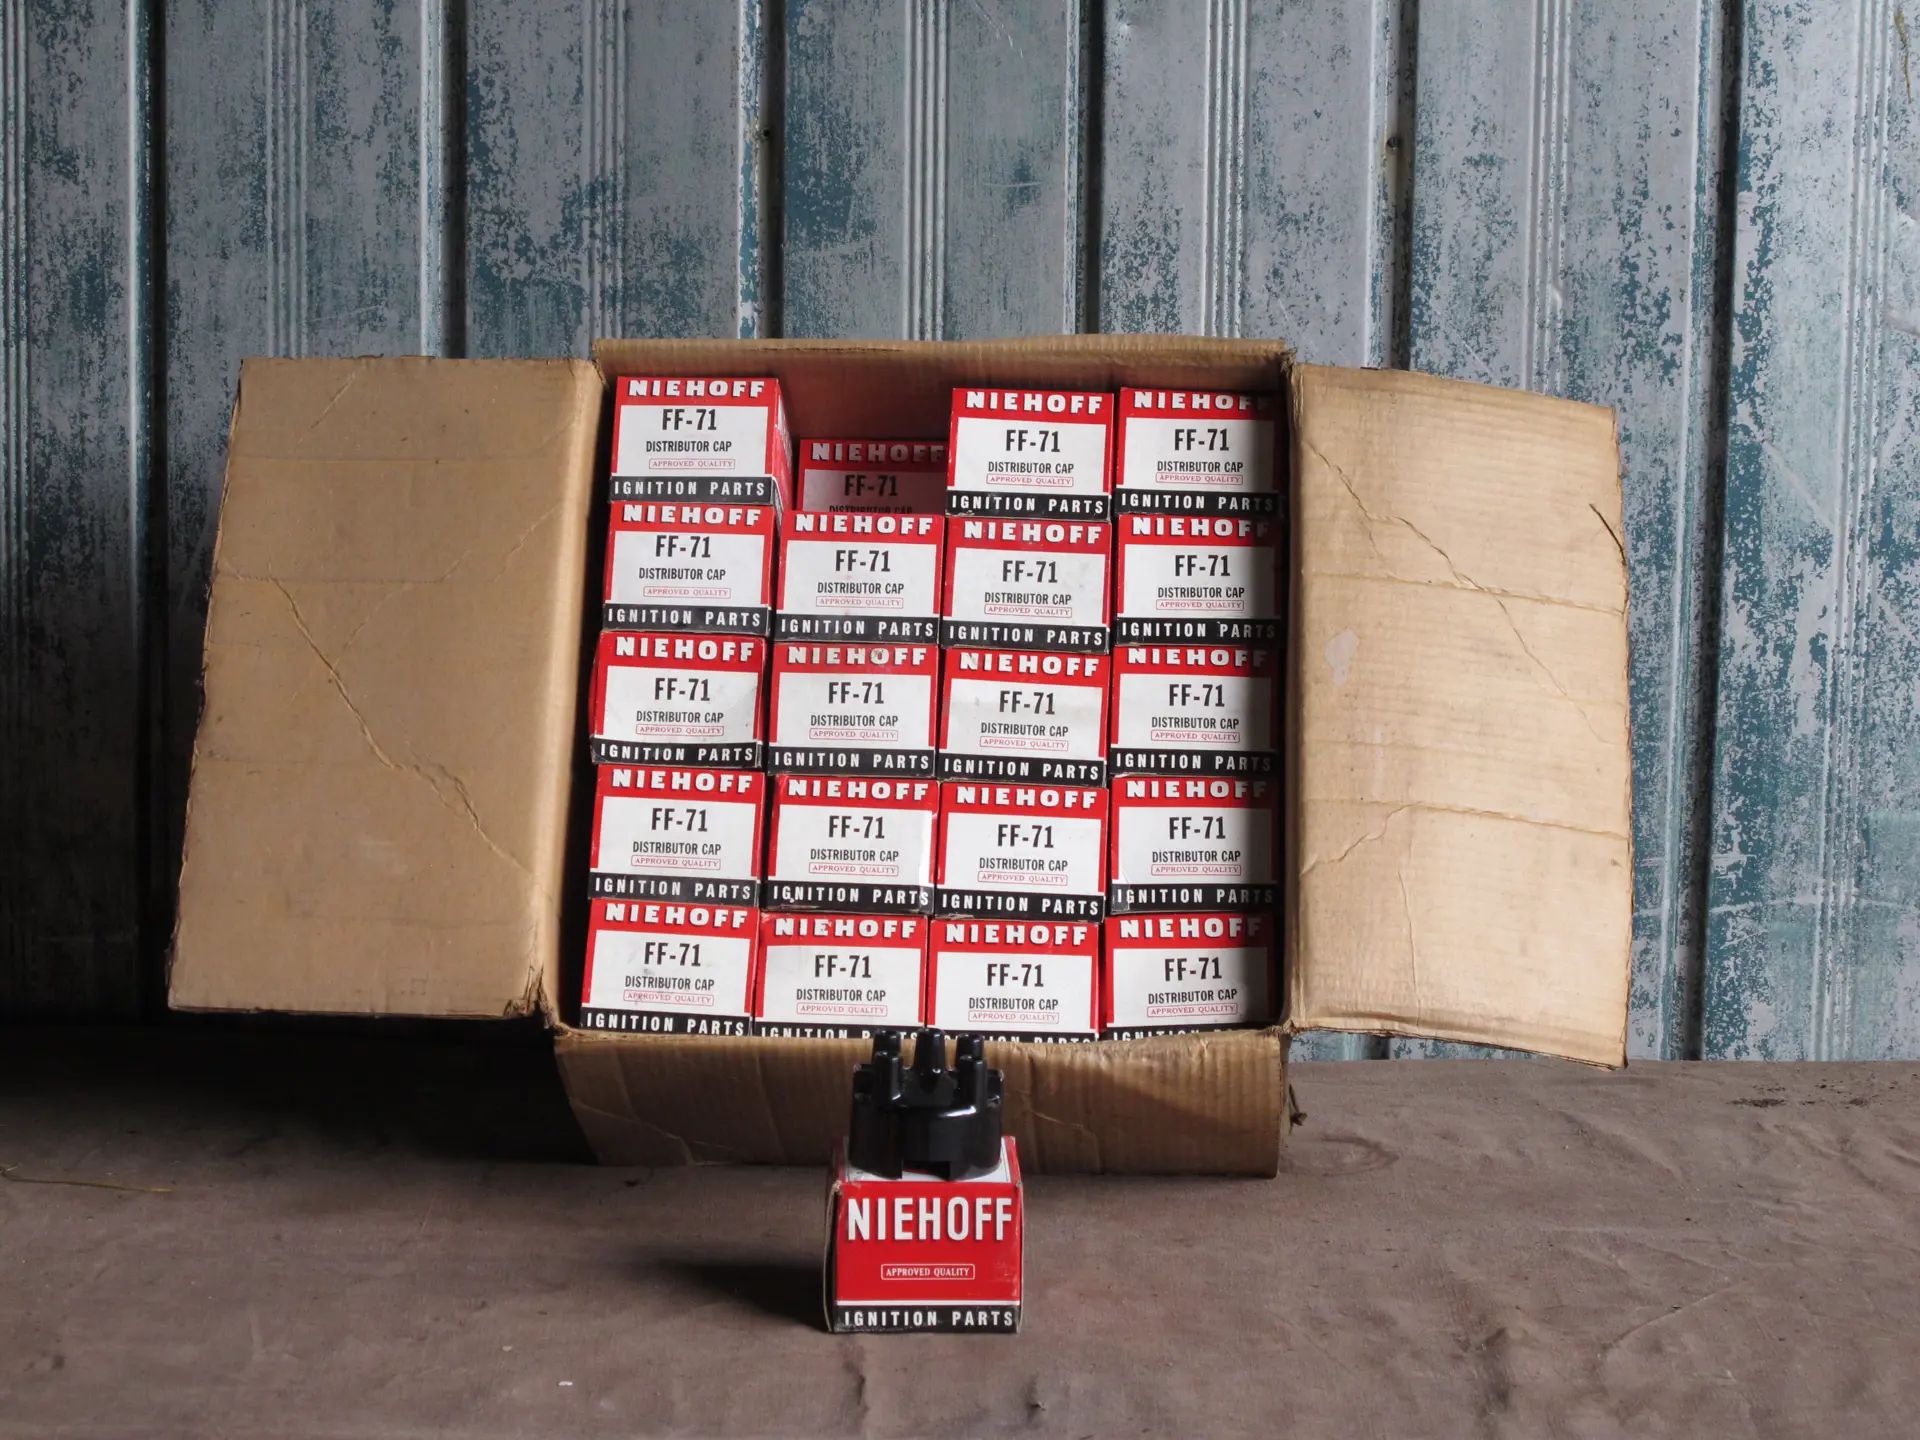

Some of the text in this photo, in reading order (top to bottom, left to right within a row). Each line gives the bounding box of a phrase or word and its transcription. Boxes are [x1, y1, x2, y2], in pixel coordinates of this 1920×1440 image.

[628, 380, 765, 398] NIEHOFF
[966, 392, 1102, 414] NIEHOFF
[1134, 392, 1267, 411] NIEHOFF
[662, 408, 717, 430] FF-71
[646, 441, 732, 452] DISTRIBUTOR CAP
[1006, 430, 1061, 452] FF-71
[1175, 429, 1229, 451] FF-71
[811, 443, 944, 462] NIEHOFF
[653, 460, 733, 468] APPROVED QUALITY
[988, 462, 1074, 474] DISTRIBUTOR CAP
[1157, 461, 1243, 473] DISTRIBUTOR CAP
[844, 475, 898, 497] FF-71
[990, 476, 1071, 485] APPROVED QUALITY
[1160, 474, 1241, 483] APPROVED QUALITY
[615, 482, 765, 495] IGNITION PARTS
[952, 495, 1103, 514] IGNITION PARTS
[1122, 494, 1273, 511] IGNITION PARTS
[623, 505, 761, 526] NIEHOFF
[796, 514, 933, 535] NIEHOFF
[964, 521, 1102, 544] NIEHOFF
[1132, 518, 1268, 537] NIEHOFF
[656, 535, 711, 558] FF-71
[835, 550, 890, 572] FF-71
[1175, 555, 1230, 577] FF-71
[639, 568, 726, 580] DISTRIBUTOR CAP
[1002, 561, 1058, 583] FF-71
[647, 588, 729, 597] APPROVED QUALITY
[817, 582, 904, 594] DISTRIBUTOR CAP
[1158, 587, 1244, 599] DISTRIBUTOR CAP
[819, 598, 901, 607] APPROVED QUALITY
[984, 592, 1071, 605] DISTRIBUTOR CAP
[1160, 601, 1242, 610] APPROVED QUALITY
[608, 609, 760, 627] IGNITION PARTS
[988, 607, 1070, 616] APPROVED QUALITY
[781, 619, 933, 637] IGNITION PARTS
[950, 626, 1102, 645] IGNITION PARTS
[1122, 623, 1275, 639] IGNITION PARTS
[616, 637, 753, 661] NIEHOFF
[788, 647, 926, 665] NIEHOFF
[1128, 648, 1266, 667] NIEHOFF
[960, 652, 1099, 677] NIEHOFF
[654, 678, 710, 701] FF-71
[828, 682, 884, 704] FF-71
[1169, 684, 1225, 707] FF-71
[999, 691, 1055, 714] FF-71
[636, 711, 724, 723] DISTRIBUTOR CAP
[810, 715, 898, 727] DISTRIBUTOR CAP
[1152, 717, 1239, 729] DISTRIBUTOR CAP
[640, 726, 722, 735] APPROVED QUALITY
[813, 730, 896, 739] APPROVED QUALITY
[981, 723, 1068, 737] DISTRIBUTOR CAP
[1201, 733, 1238, 741] QUALITY
[601, 744, 753, 761] IGNITION PARTS
[983, 739, 1066, 749] APPROVED QUALITY
[775, 752, 928, 769] IGNITION PARTS
[944, 759, 1098, 779] IGNITION PARTS
[1116, 754, 1270, 770] IGNITION PARTS
[612, 769, 752, 793] NIEHOFF
[1127, 781, 1266, 799] NIEHOFF
[788, 780, 929, 801] NIEHOFF
[957, 787, 1097, 809] NIEHOFF
[652, 808, 708, 832] FF-71
[829, 816, 884, 839] FF-71
[1169, 817, 1225, 839] FF-71
[998, 824, 1054, 848] FF-71
[633, 841, 721, 855] DISTRIBUTOR CAP
[810, 849, 899, 862] DISTRIBUTOR CAP
[1152, 851, 1241, 862] DISTRIBUTOR CAP
[635, 857, 718, 867] APPROVED QUALITY
[813, 864, 896, 874] APPROVED QUALITY
[979, 858, 1068, 871] DISTRIBUTOR CAP
[1155, 866, 1239, 874] APPROVED QUALITY
[982, 874, 1065, 884] APPROVED QUALITY
[595, 878, 750, 899] IGNITION PARTS
[774, 886, 929, 905] IGNITION PARTS
[1118, 889, 1273, 903] IGNITION PARTS
[942, 894, 1098, 915] IGNITION PARTS
[605, 903, 748, 928] NIEHOFF
[775, 918, 917, 938] NIEHOFF
[946, 924, 1088, 946] NIEHOFF
[1120, 918, 1262, 939] NIEHOFF
[644, 942, 701, 966] FF-71
[815, 955, 871, 978] FF-71
[987, 964, 1044, 987] FF-71
[1165, 957, 1222, 981] FF-71
[625, 975, 714, 990] DISTRIBUTOR CAP
[797, 989, 886, 1001] DISTRIBUTOR CAP
[969, 998, 1058, 1010] DISTRIBUTOR CAP
[1148, 988, 1237, 1005] DISTRIBUTOR CAP
[800, 1005, 845, 1013] APPROVED
[1151, 1004, 1236, 1016] APPROVED QUALITY
[587, 1013, 744, 1035] IGNITION PARTS
[848, 1197, 1012, 1241] NIEHOFF
[886, 1268, 969, 1276] APPROVED QUALITY
[845, 1311, 1012, 1326] IGNITION PARTS
